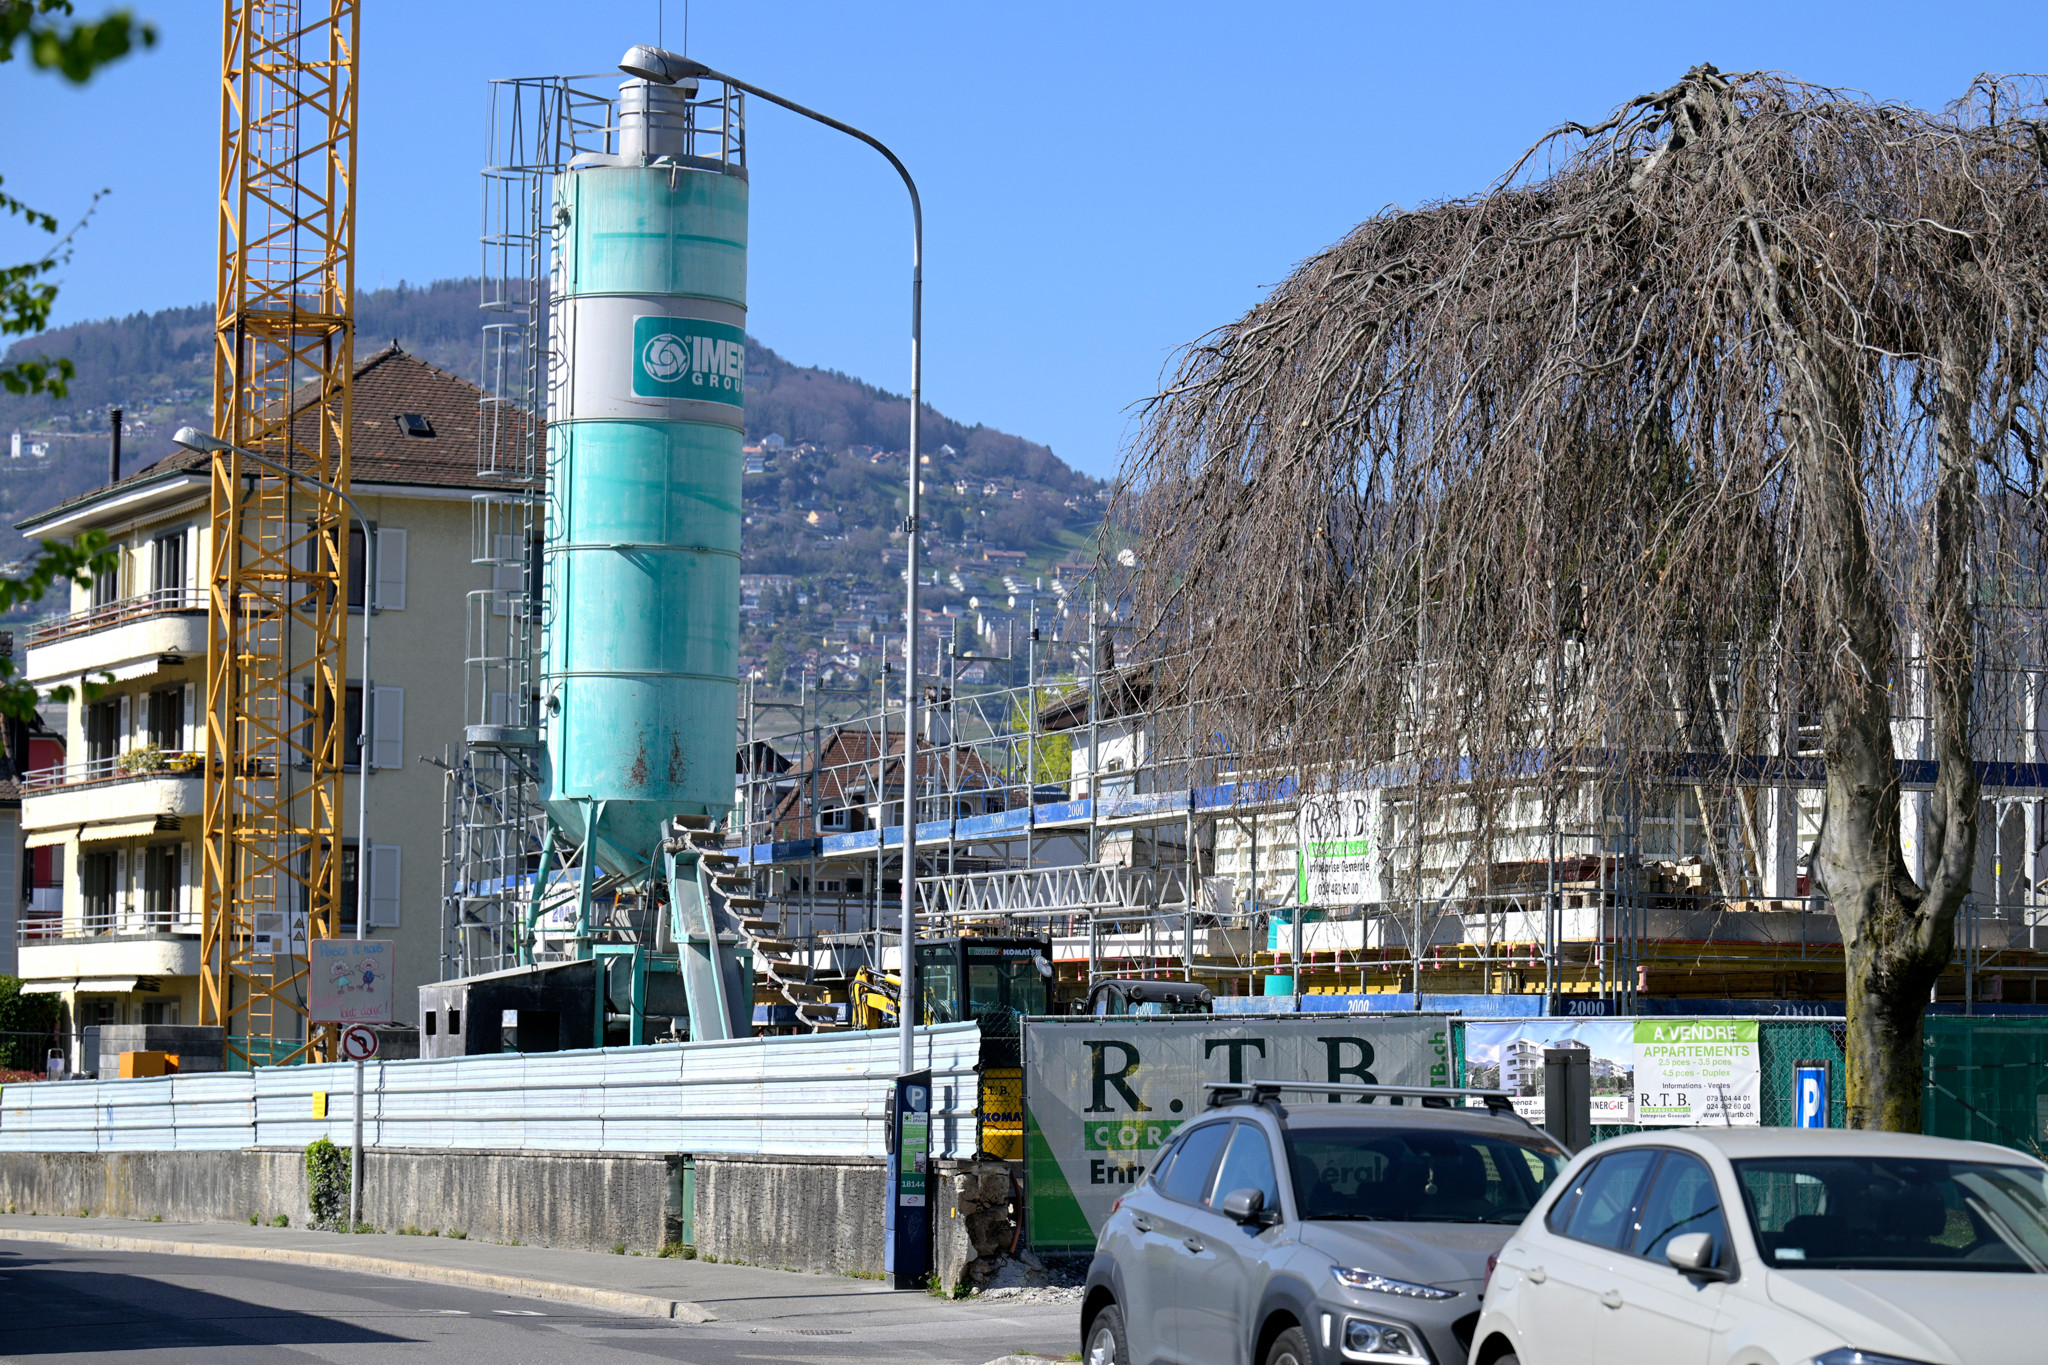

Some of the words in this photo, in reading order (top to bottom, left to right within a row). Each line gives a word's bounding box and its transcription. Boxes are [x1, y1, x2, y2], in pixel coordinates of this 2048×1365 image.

[691, 372, 744, 394] GROU
[1067, 803, 1084, 818] 2000
[990, 814, 1005, 829] 2000
[1568, 1001, 1605, 1016] 2000
[1653, 1026, 1666, 1041] A
[1668, 1025, 1738, 1041] VENDRE
[1643, 1045, 1750, 1058] APPARTEMENTS
[1658, 1058, 1671, 1066] 2.5
[1672, 1059, 1691, 1068] pces
[1698, 1058, 1711, 1066] 3.5
[1712, 1058, 1732, 1068] pces
[1662, 1069, 1674, 1077] 4.5
[1675, 1070, 1694, 1079] pces
[1702, 1068, 1731, 1078] Duplex
[911, 1087, 925, 1108] P
[1803, 1077, 1820, 1128] P
[983, 1112, 1022, 1122] KOMA
[1094, 1125, 1177, 1147] COR
[901, 1180, 926, 1188] 18144
